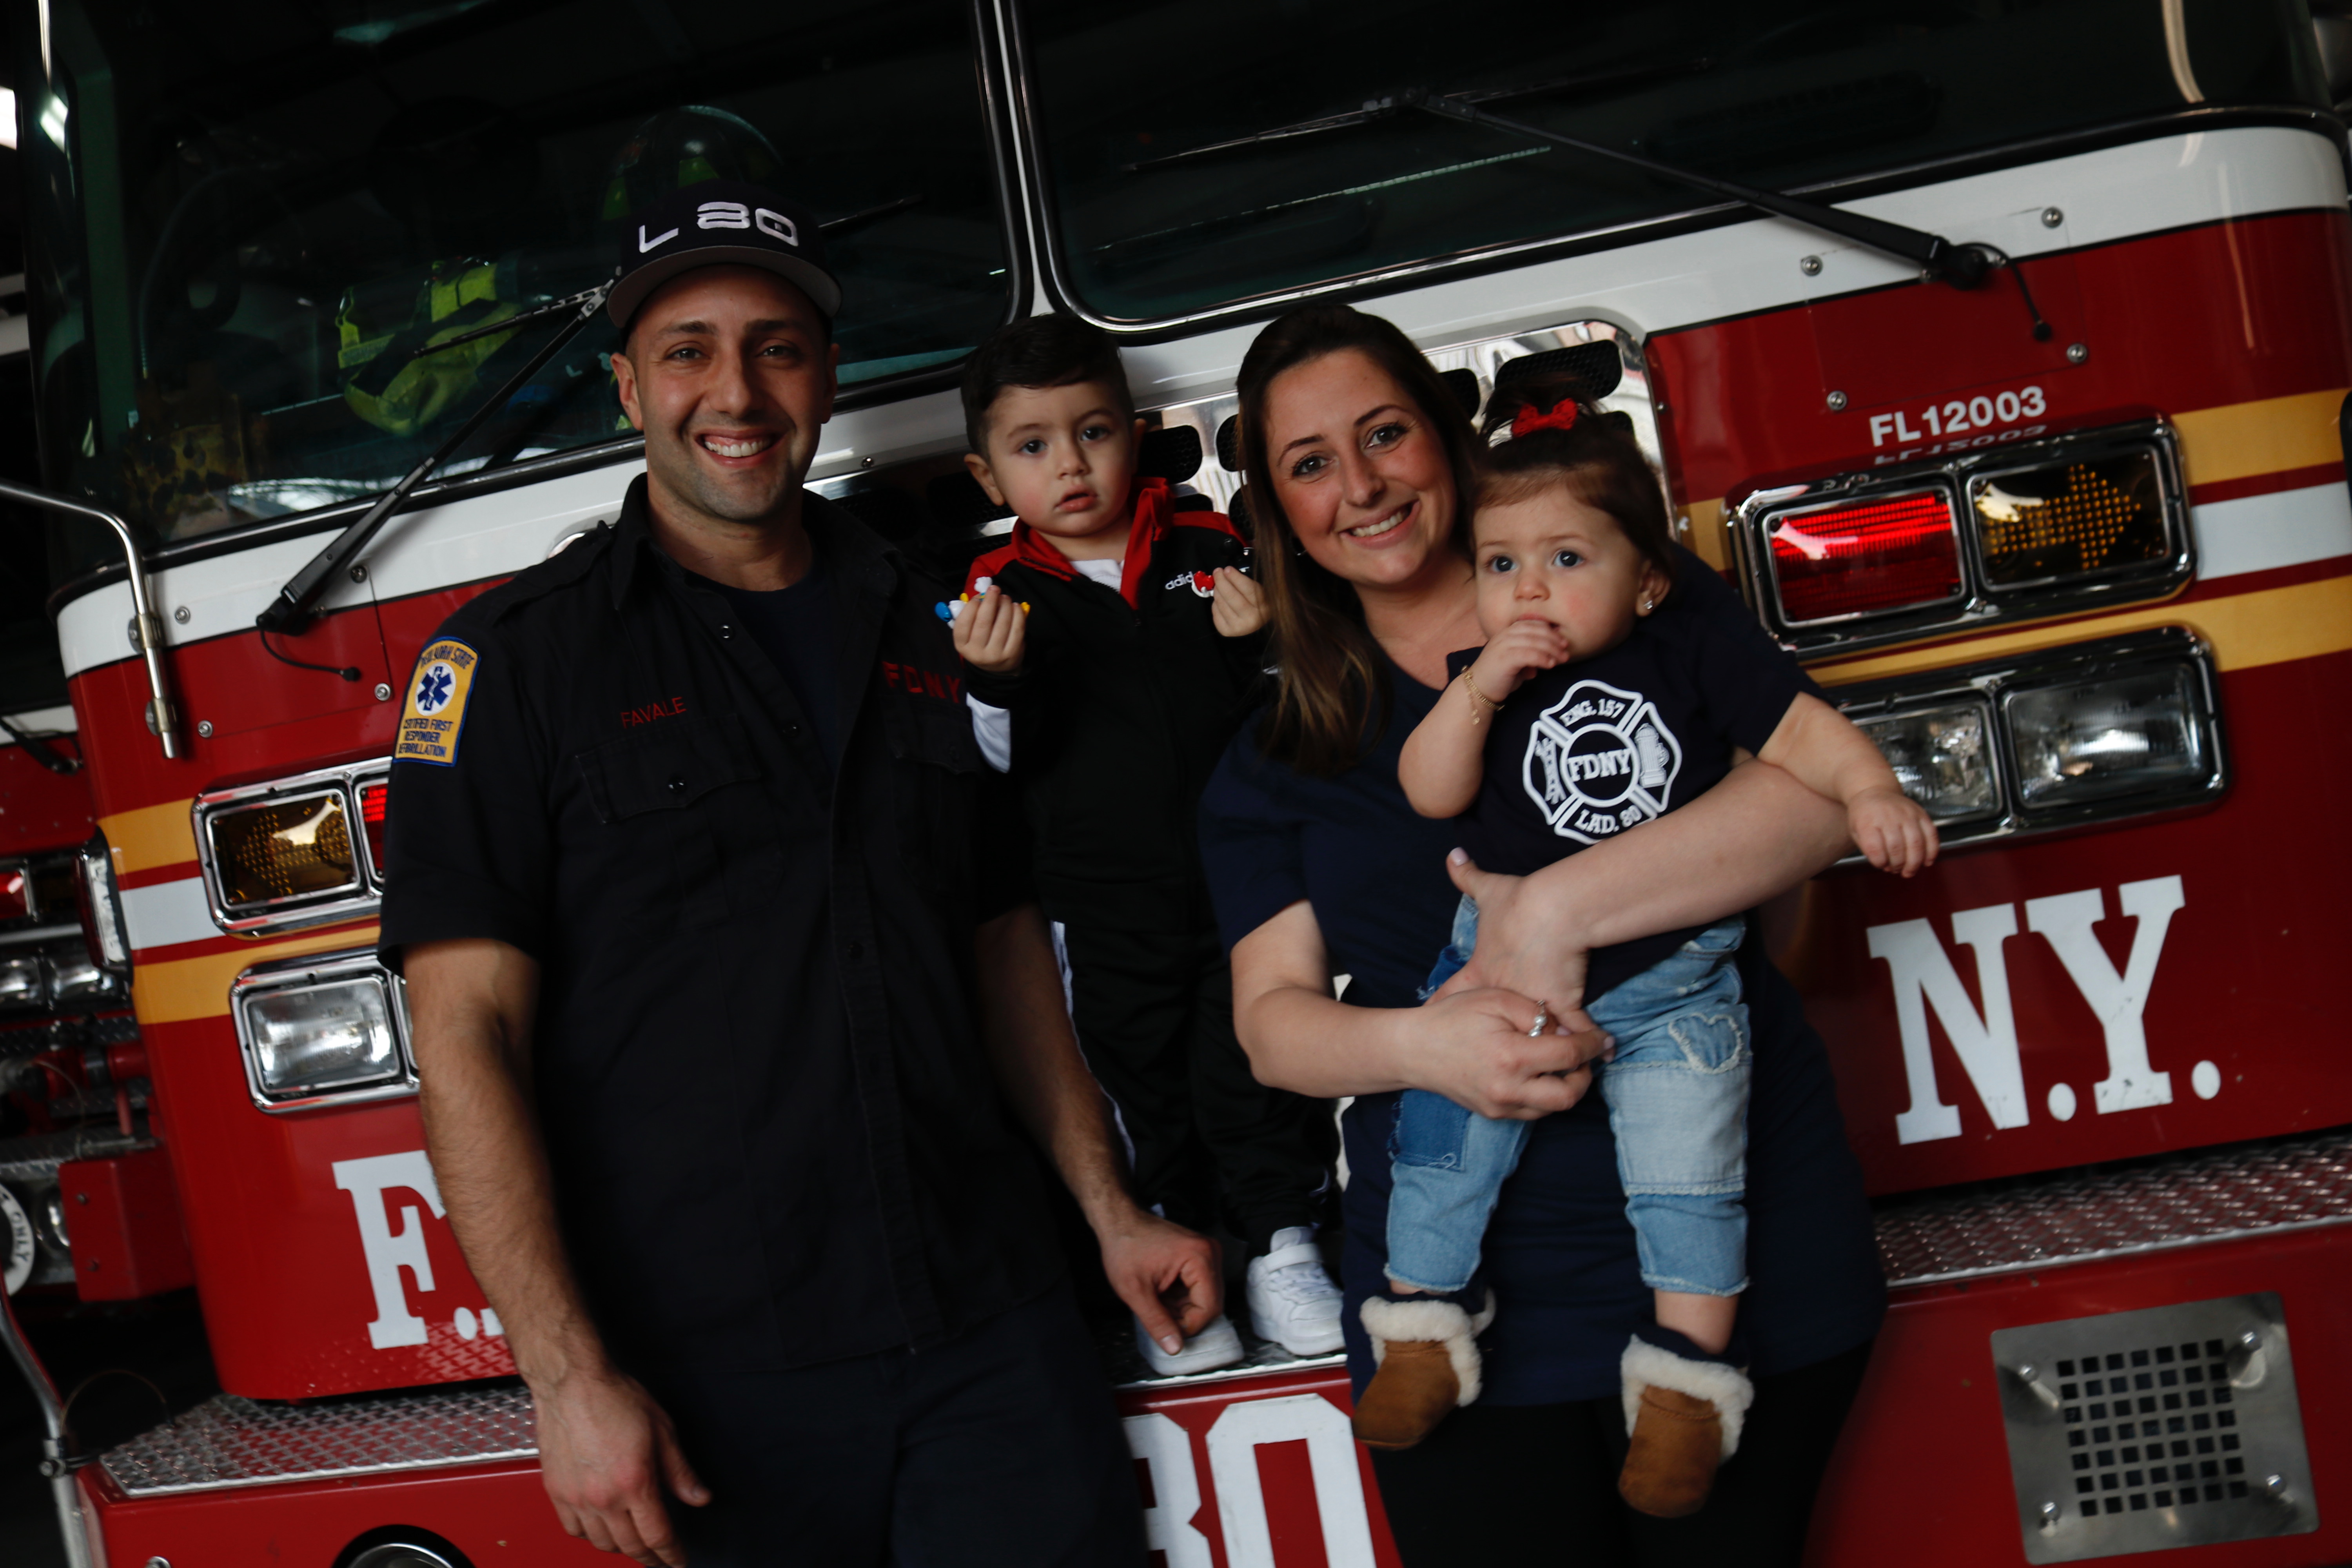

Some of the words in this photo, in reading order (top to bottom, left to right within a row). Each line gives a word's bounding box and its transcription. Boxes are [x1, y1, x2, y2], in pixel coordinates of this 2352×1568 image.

[639, 224, 679, 254] L
[697, 201, 799, 247] 80
[1869, 385, 2047, 447] FL12003
[1165, 570, 1194, 590] adid
[882, 661, 961, 704] FDNY
[620, 696, 687, 729] FAVALE
[1559, 700, 1596, 727] ENG.
[1597, 698, 1626, 719] 157
[1567, 748, 1632, 782] FDNY
[1574, 808, 1619, 834] LAD.
[1619, 805, 1642, 828] 80
[1866, 874, 2221, 1146] N.Y.
[331, 1149, 505, 1349] F.
